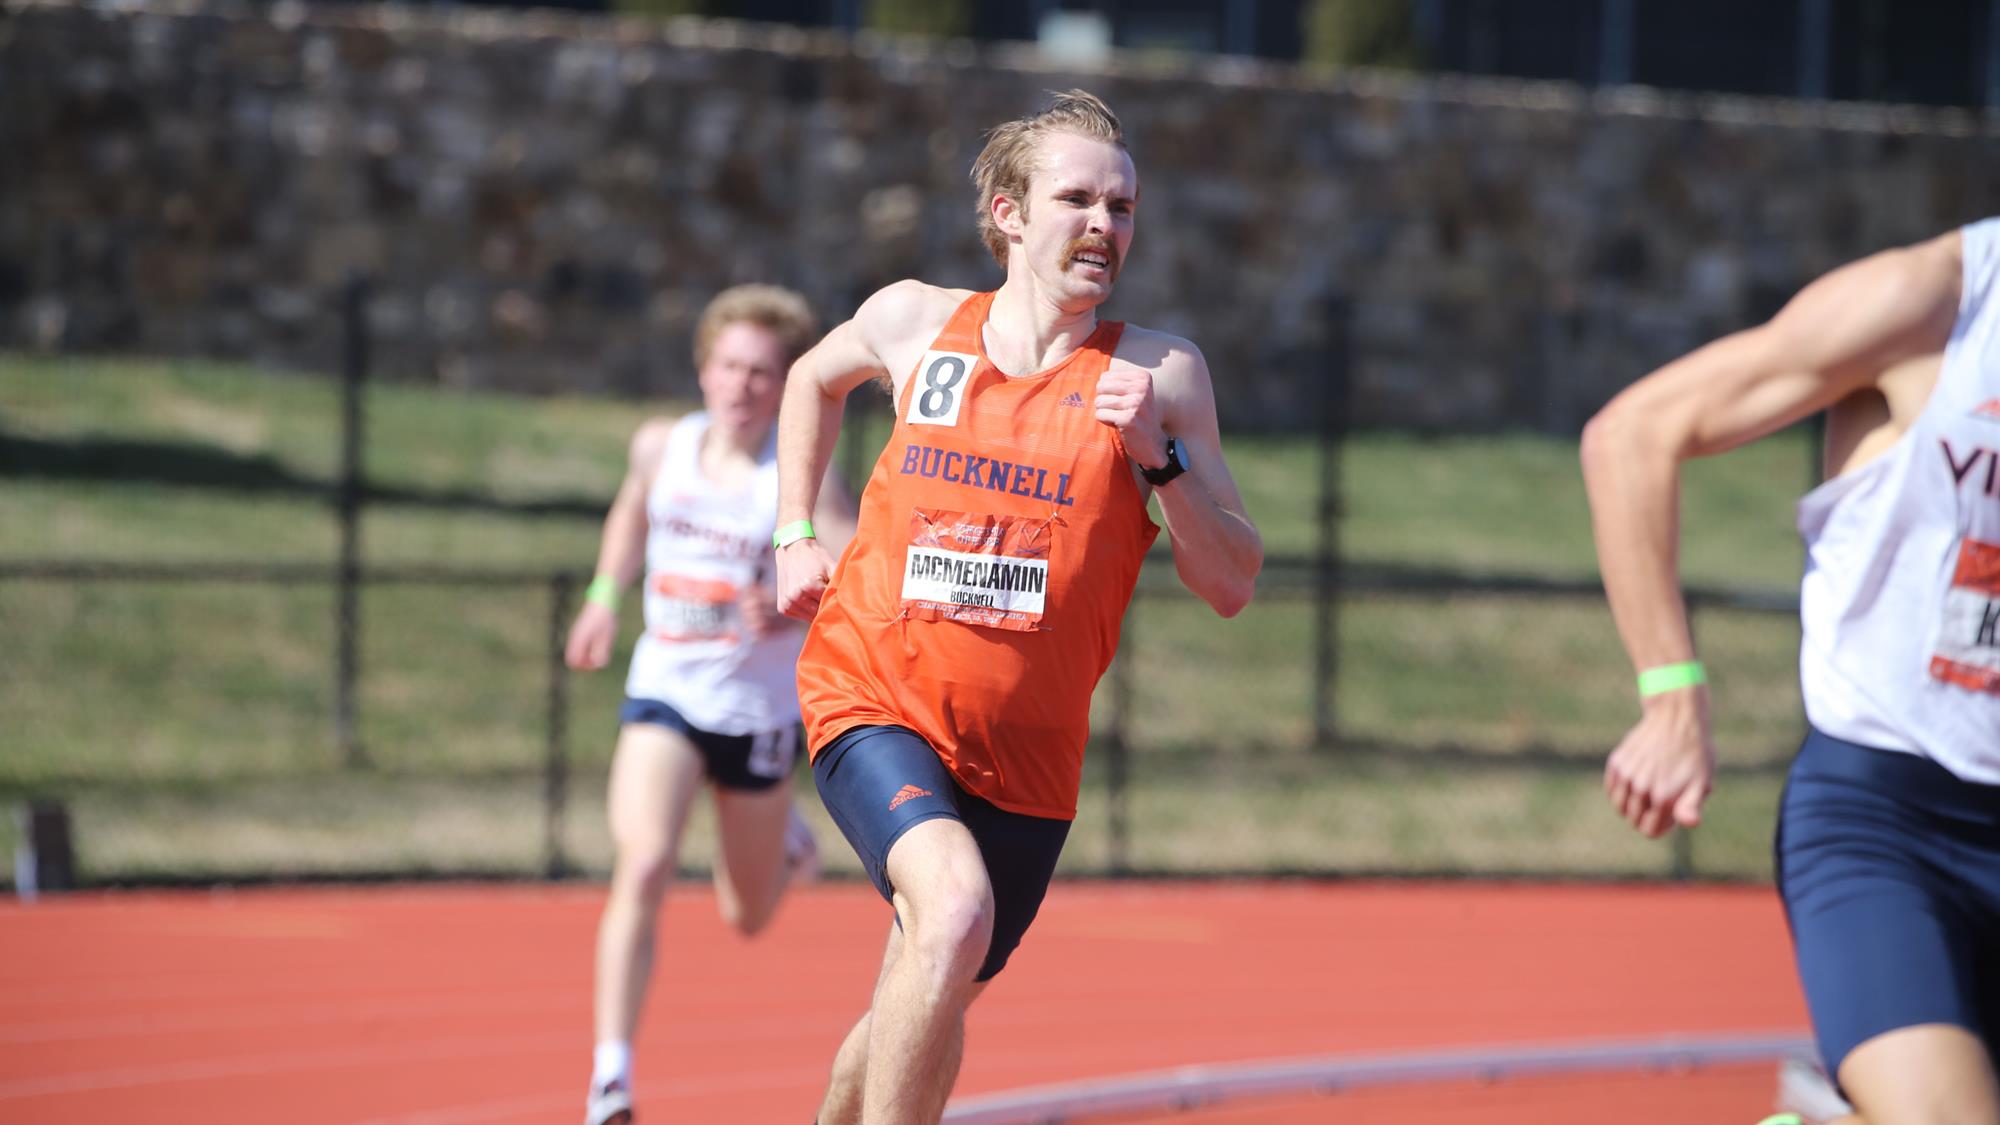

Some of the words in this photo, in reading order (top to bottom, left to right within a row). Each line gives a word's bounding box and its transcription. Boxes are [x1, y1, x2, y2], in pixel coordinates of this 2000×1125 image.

[918, 356, 966, 418] 8
[900, 444, 1074, 506] BUCKNELL
[910, 554, 1044, 594] MCMENAMIN
[950, 591, 995, 608] BUCKNELL
[888, 790, 933, 812] adidas
